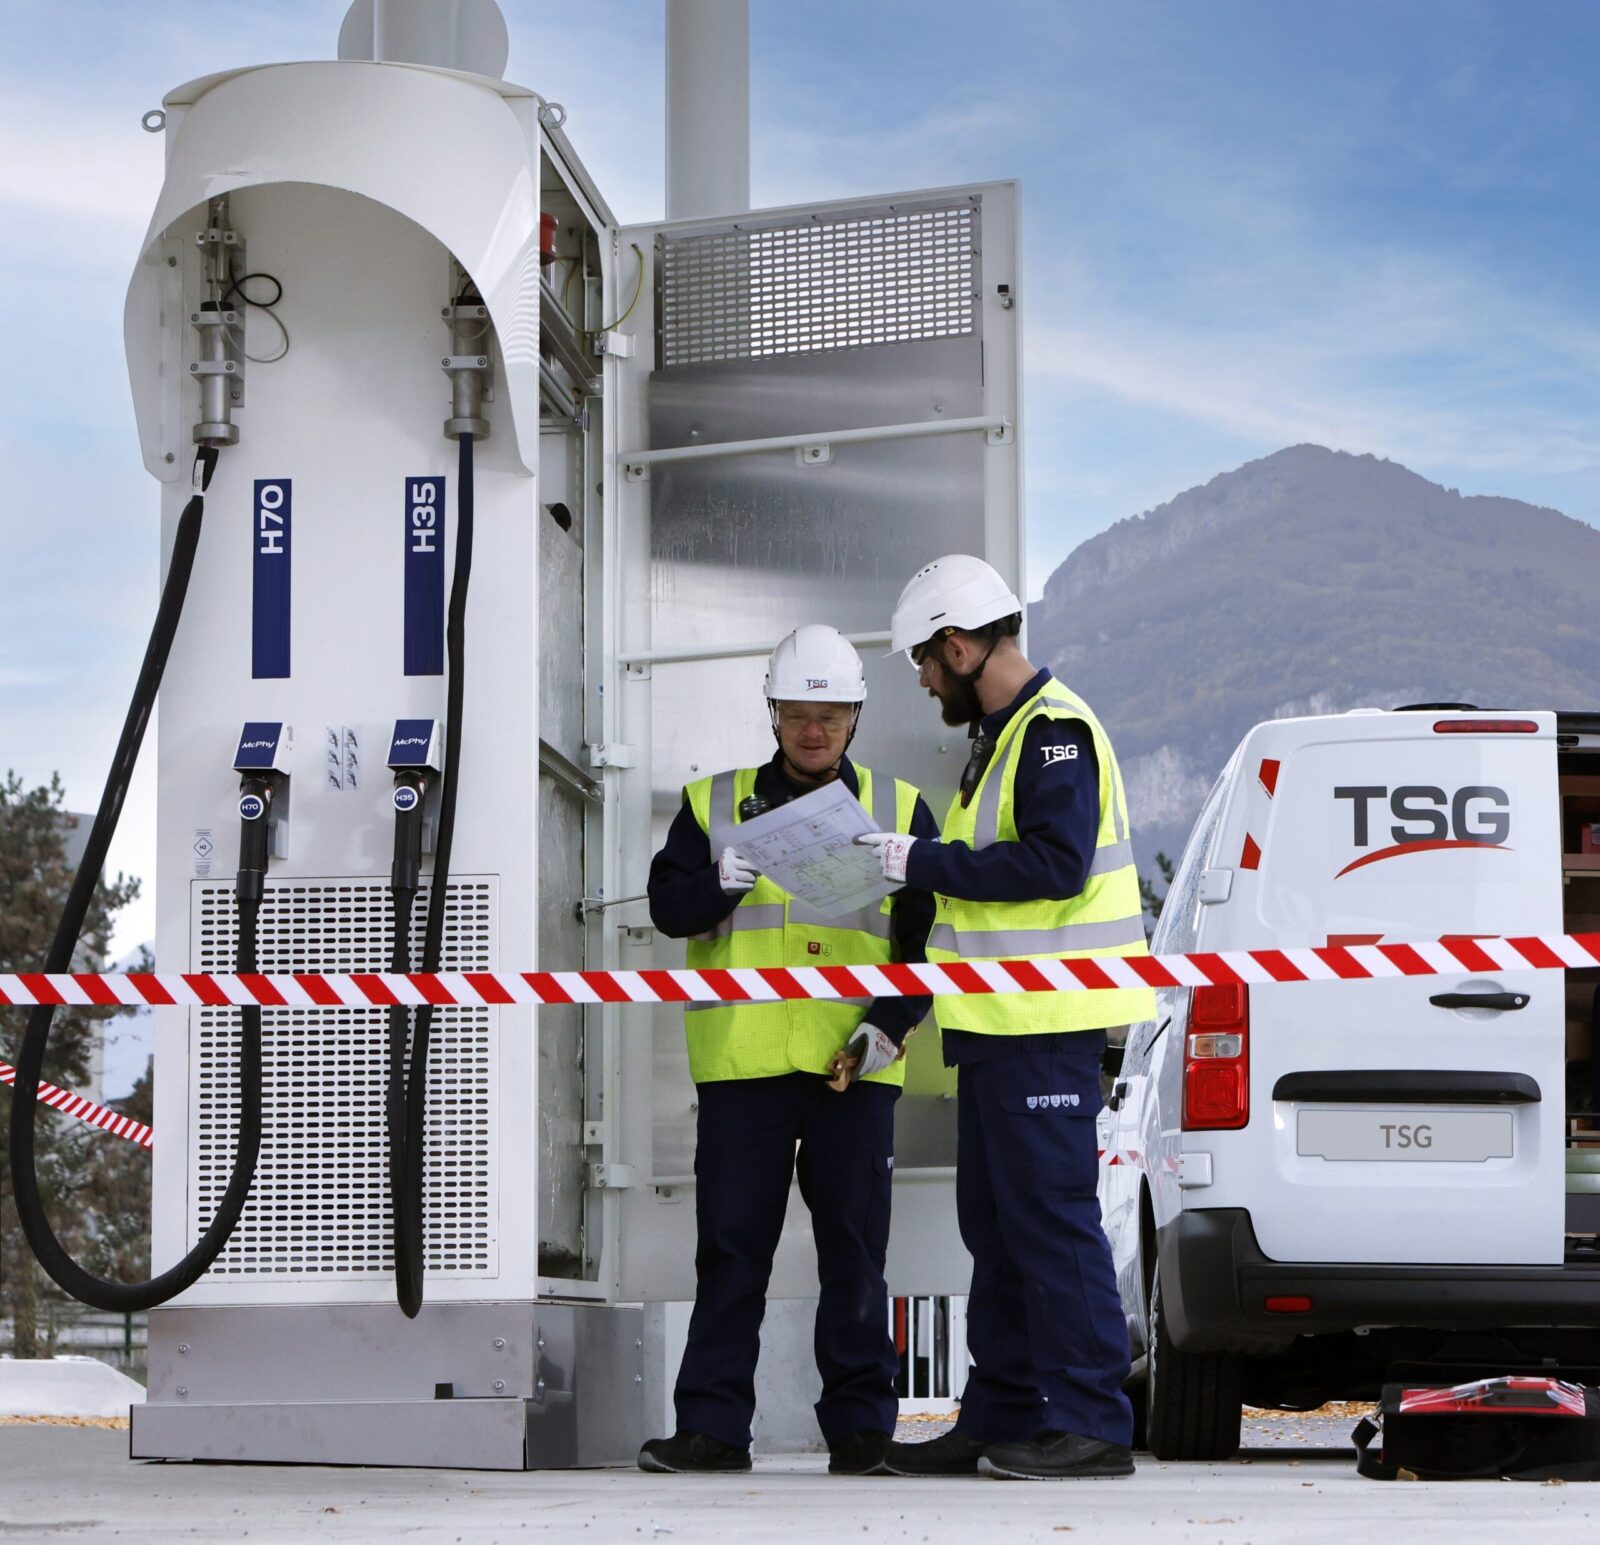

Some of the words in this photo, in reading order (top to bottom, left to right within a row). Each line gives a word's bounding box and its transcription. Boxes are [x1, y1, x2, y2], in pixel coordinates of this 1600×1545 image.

[260, 483, 284, 555] H70
[412, 481, 436, 553] H35
[805, 679, 829, 689] TSG
[241, 741, 275, 749] McPhy
[394, 737, 428, 746] McPhy
[1040, 744, 1079, 761] TSG
[396, 794, 413, 802] H35
[241, 803, 259, 811] H70
[1333, 785, 1511, 847] TSG
[1379, 1124, 1433, 1149] TSG
